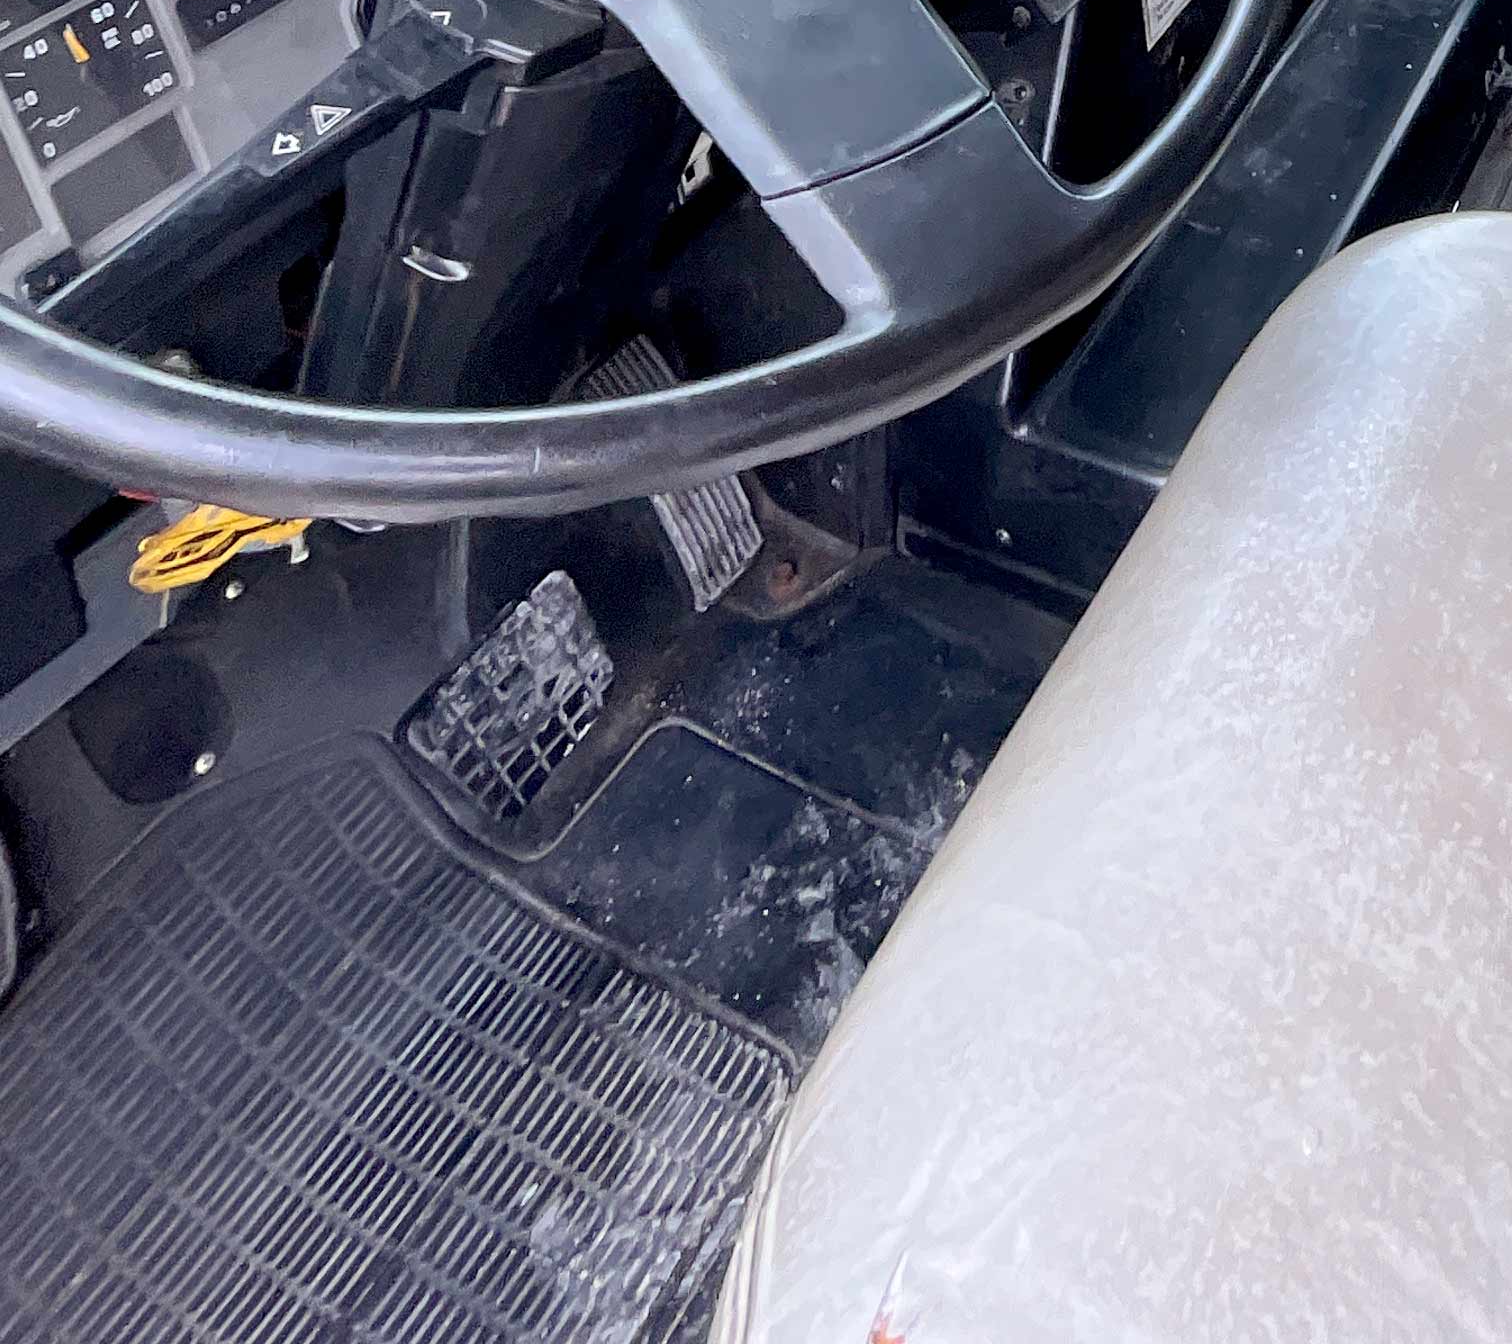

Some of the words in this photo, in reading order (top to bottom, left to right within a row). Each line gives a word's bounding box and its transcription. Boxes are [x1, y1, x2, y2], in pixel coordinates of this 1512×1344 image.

[90, 1, 116, 25] 60
[23, 38, 49, 60] 40
[142, 71, 174, 97] 100
